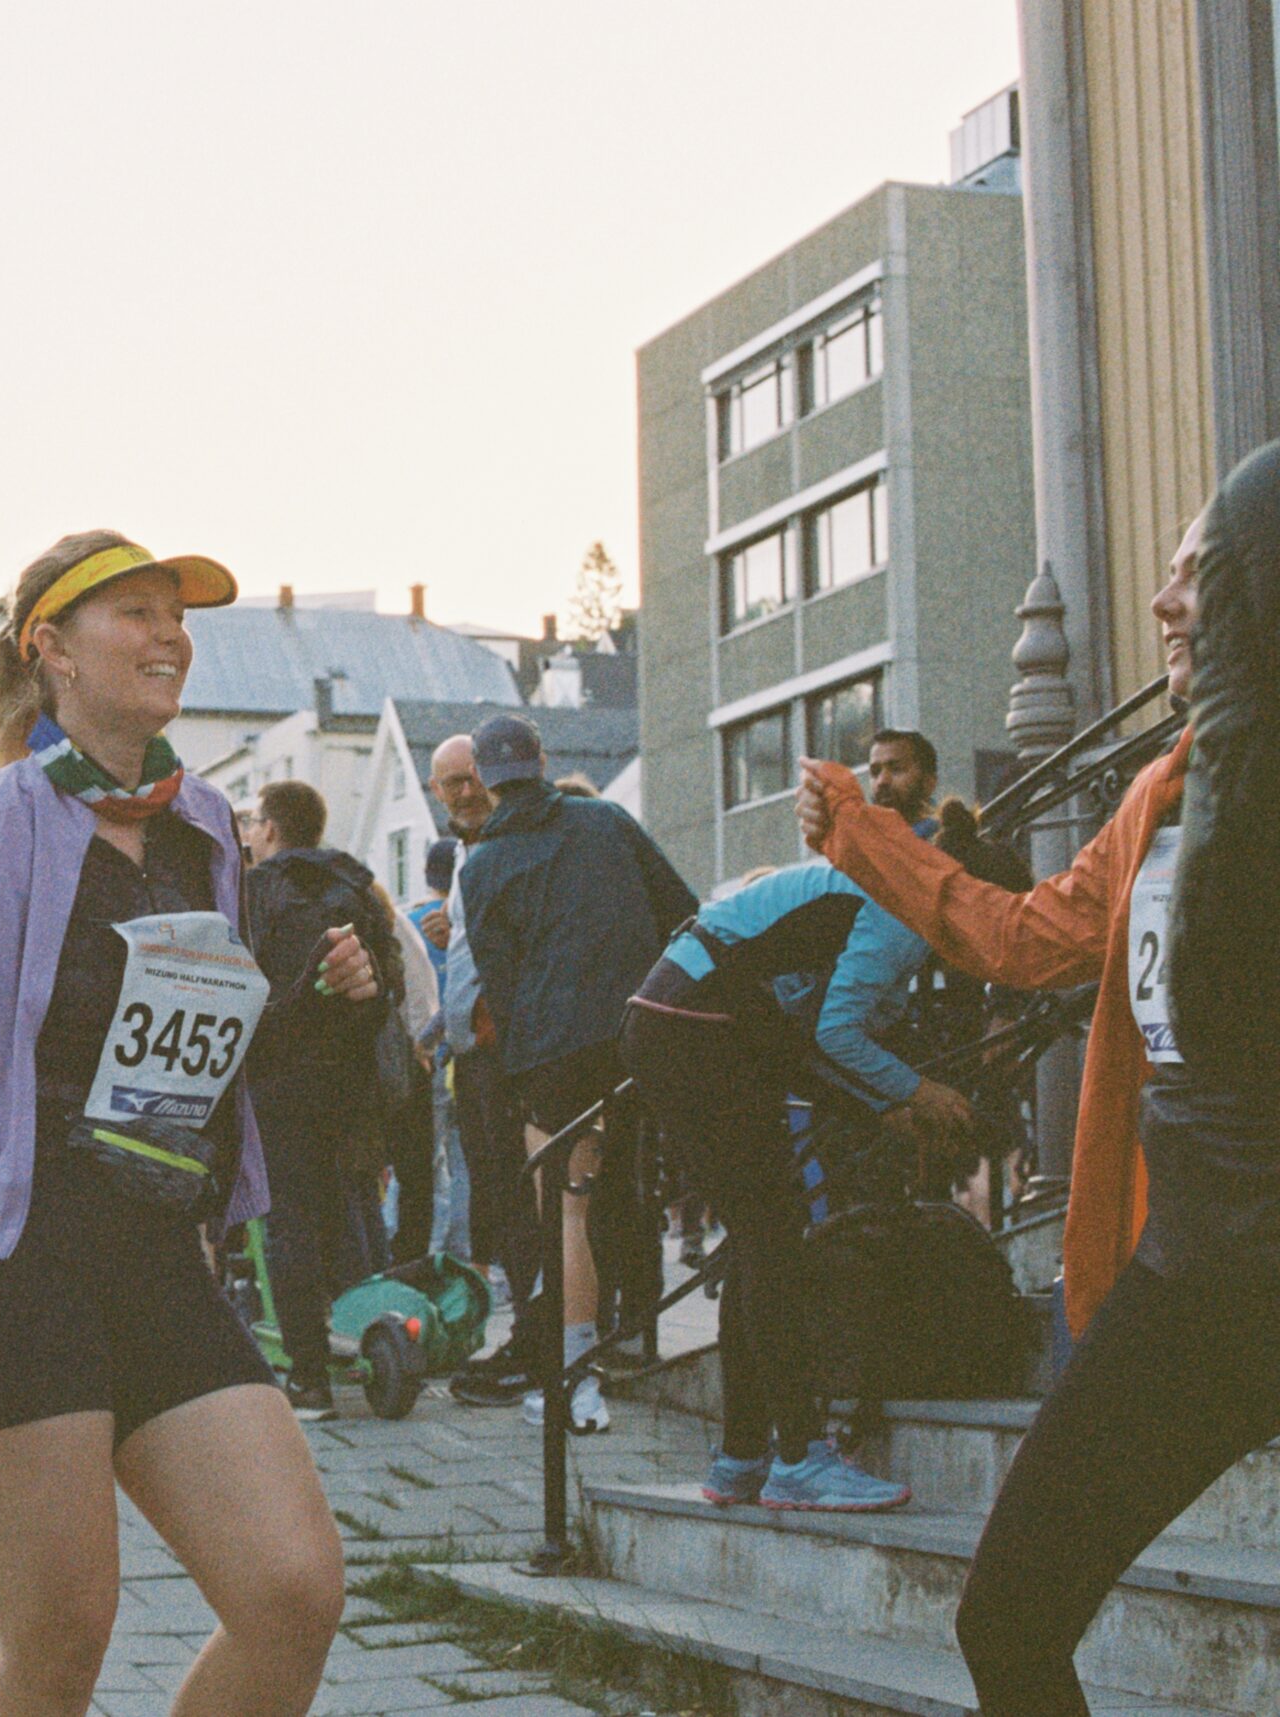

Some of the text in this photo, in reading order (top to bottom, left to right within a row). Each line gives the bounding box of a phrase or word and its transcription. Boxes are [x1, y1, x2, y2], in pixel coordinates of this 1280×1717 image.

[145, 967, 178, 980] MIZUNO
[180, 973, 247, 991] HALFMARATHON
[114, 1002, 243, 1078] 3453
